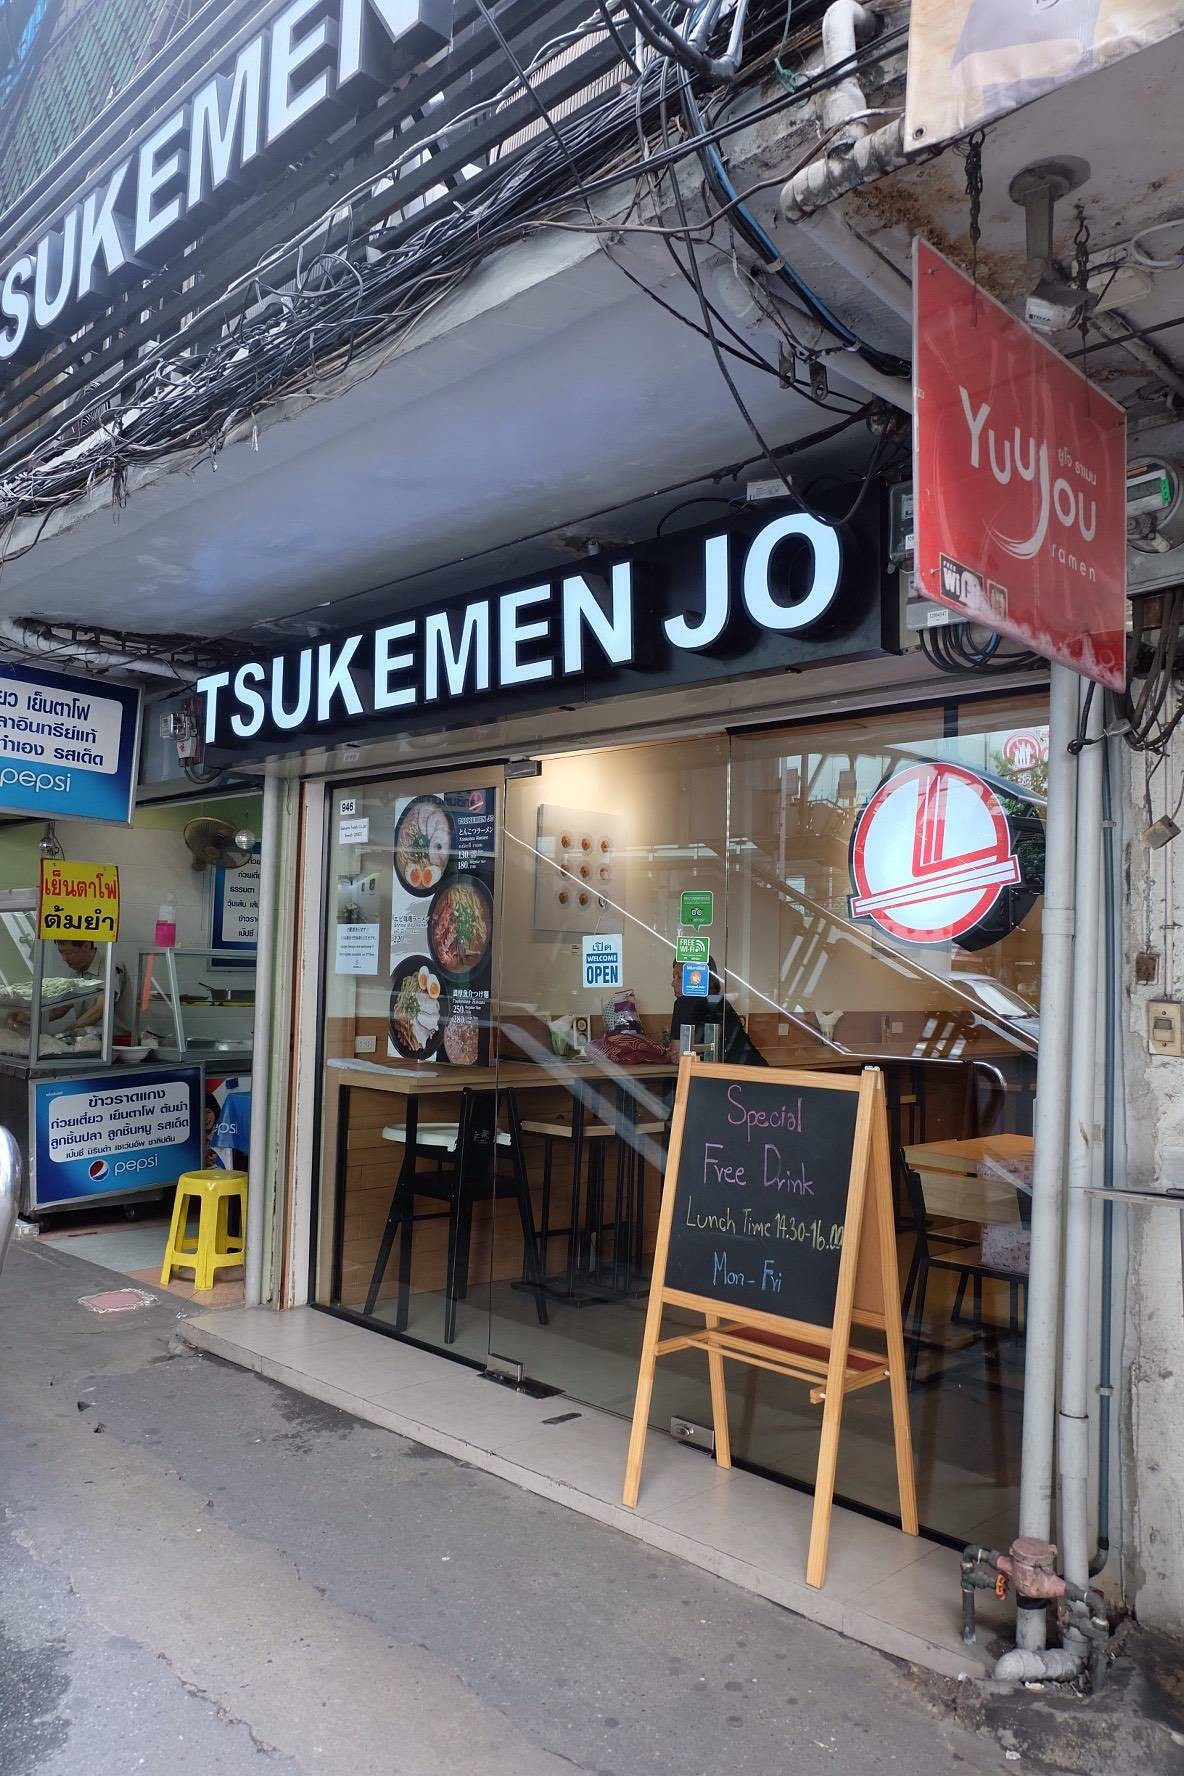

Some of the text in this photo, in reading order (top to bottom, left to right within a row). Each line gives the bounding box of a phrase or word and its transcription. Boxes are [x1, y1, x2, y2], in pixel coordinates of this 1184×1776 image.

[1051, 543, 1096, 583] ramen
[196, 512, 840, 744] TSUKEMEN JO
[27, 691, 91, 720] เย็นตาโฟ
[0, 767, 71, 792] pepsi
[44, 869, 117, 899] เย็นตาโฟ
[44, 904, 114, 931] ต้มยำ
[680, 938, 696, 946] FREE
[586, 965, 618, 985] OPEN
[89, 1088, 166, 1108] ข้าวราดแกง
[727, 1084, 803, 1143] Special
[114, 1153, 158, 1176] pepsi
[703, 1142, 815, 1196] Free Drink
[686, 1195, 737, 1236] Lunch
[742, 1207, 771, 1237] Time
